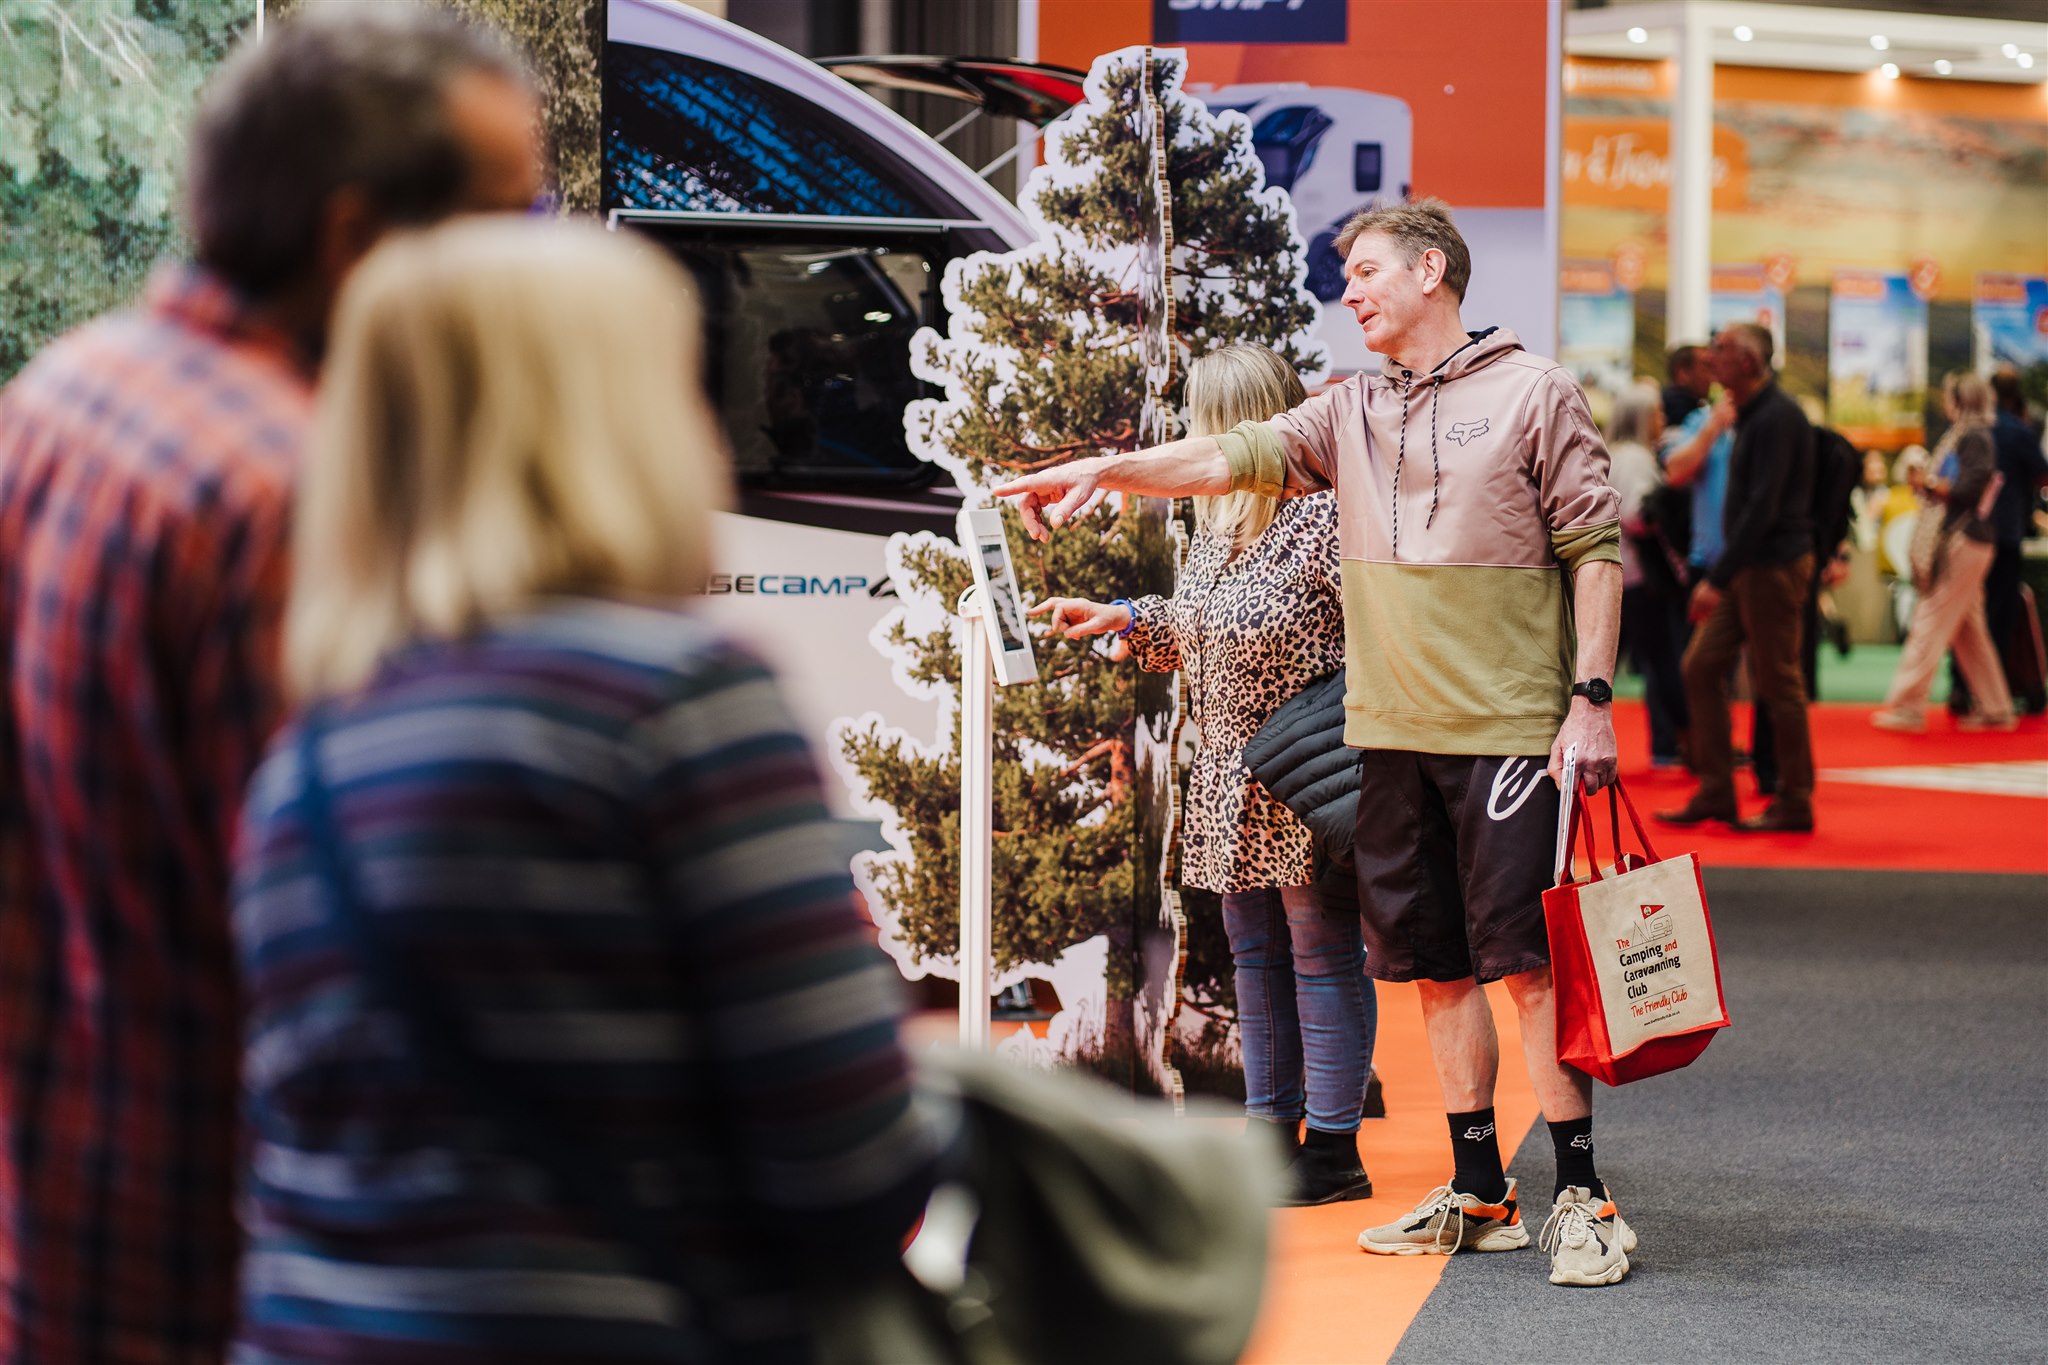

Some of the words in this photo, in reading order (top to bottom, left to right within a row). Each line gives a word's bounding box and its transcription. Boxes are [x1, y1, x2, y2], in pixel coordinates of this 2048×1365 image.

[1616, 938, 1630, 949] The
[1620, 944, 1663, 967] Camping
[1664, 939, 1678, 952] and
[1624, 955, 1681, 983] Caravanning
[1627, 982, 1648, 999] Club
[1631, 1005, 1644, 1018] The
[1644, 995, 1671, 1014] Friendly
[1671, 989, 1688, 1004] Club
